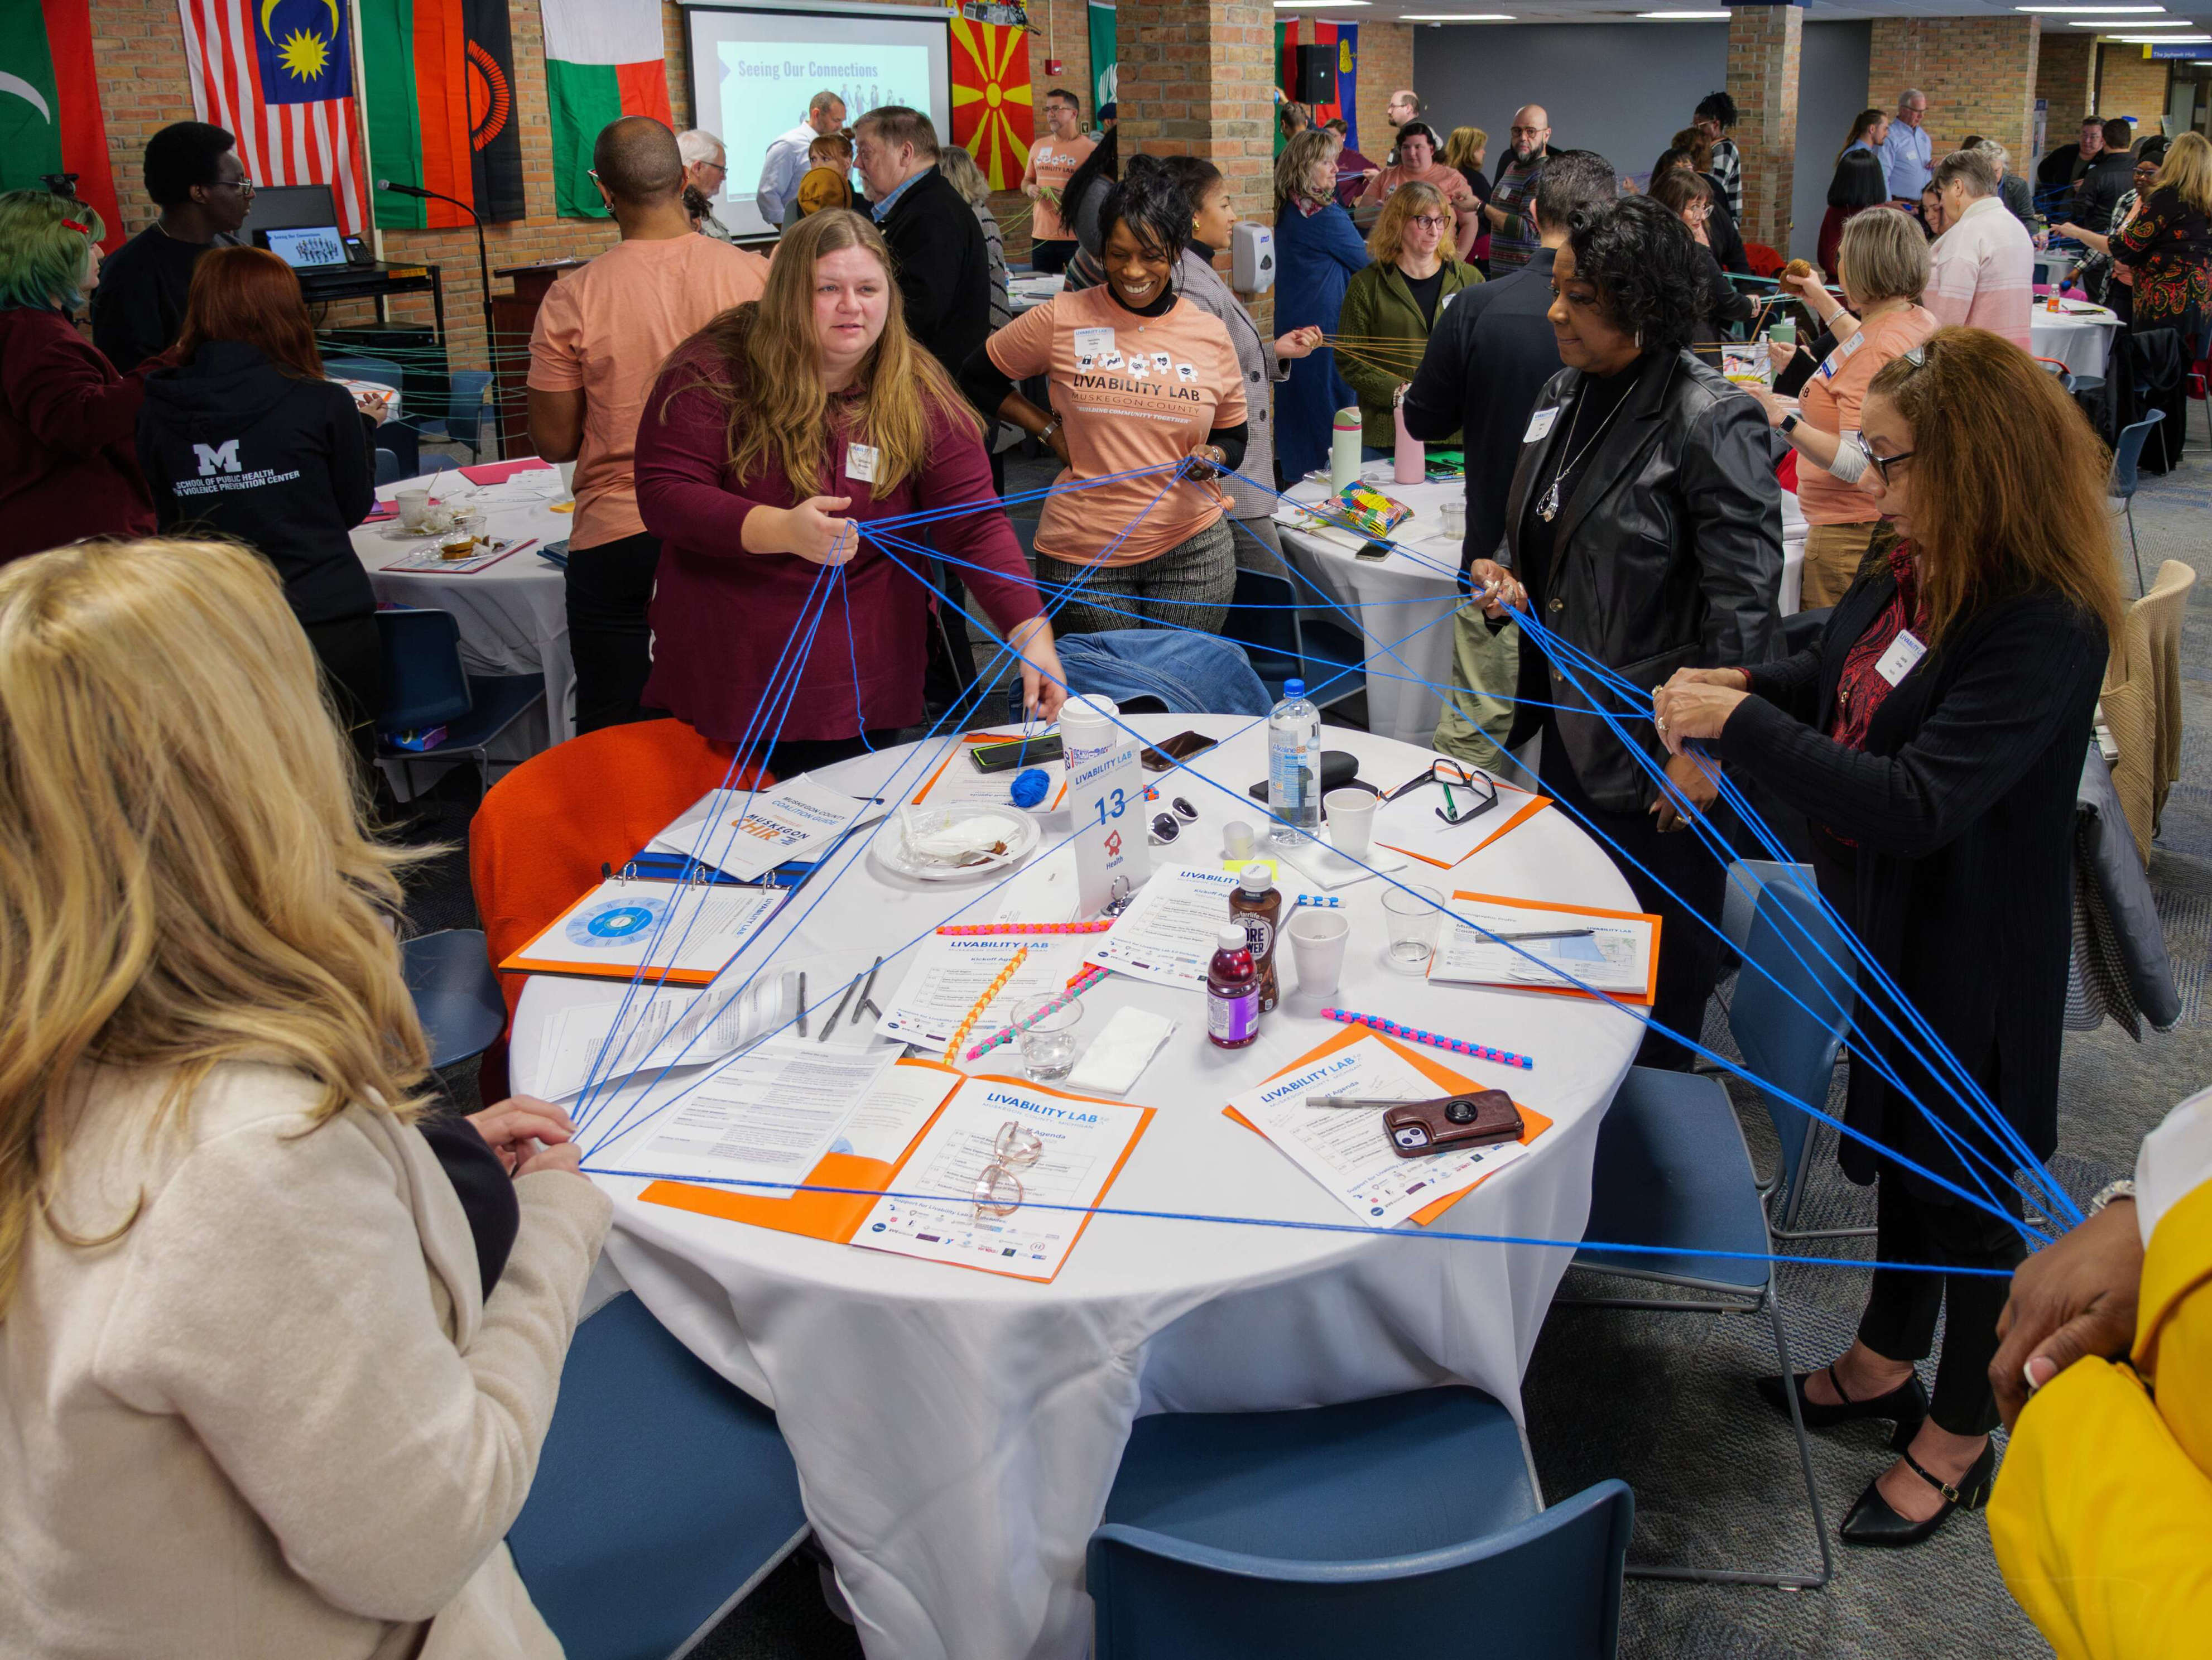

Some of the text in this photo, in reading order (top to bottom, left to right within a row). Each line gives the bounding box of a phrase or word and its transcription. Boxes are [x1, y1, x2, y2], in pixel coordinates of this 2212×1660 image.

[738, 60, 878, 80] Seeing Our Connections
[1074, 373, 1200, 401] LIVABILITY LAB
[1072, 392, 1200, 415] MUSKEGON COUNTY
[1109, 408, 1152, 420] COMMUNITY
[193, 439, 242, 476] M
[176, 469, 274, 489] SCHOOL OF PUBLIC HEALTH
[184, 484, 219, 496] VIOLENCE
[219, 478, 266, 491] PREVENTION
[267, 470, 300, 484] CENTER
[1075, 758, 1116, 785] LIVABILITY
[1117, 750, 1132, 764] LAB
[772, 800, 813, 819] COALITION
[812, 815, 839, 826] GUIDE
[782, 796, 847, 820] MUSKEGON COUNTY
[1095, 788, 1126, 826] 13
[730, 817, 781, 841] CHIR
[746, 814, 811, 839] MUSKEGON
[1106, 855, 1124, 870] Health
[1180, 870, 1240, 886] LIVABILITY
[1244, 927, 1264, 942] ORE
[1260, 1068, 1328, 1103] LIVABILITY
[1328, 1056, 1355, 1072] LAB
[1332, 1080, 1359, 1096] Agenda
[982, 1102, 1023, 1115] MUSKEGON
[1058, 1120, 1094, 1130] MICHIGAN
[987, 1093, 1066, 1118] LIVABILITY
[1067, 1112, 1099, 1123] LAB
[1034, 1129, 1067, 1140] Agenda
[893, 1197, 918, 1206] Support
[929, 1205, 956, 1215] Livability
